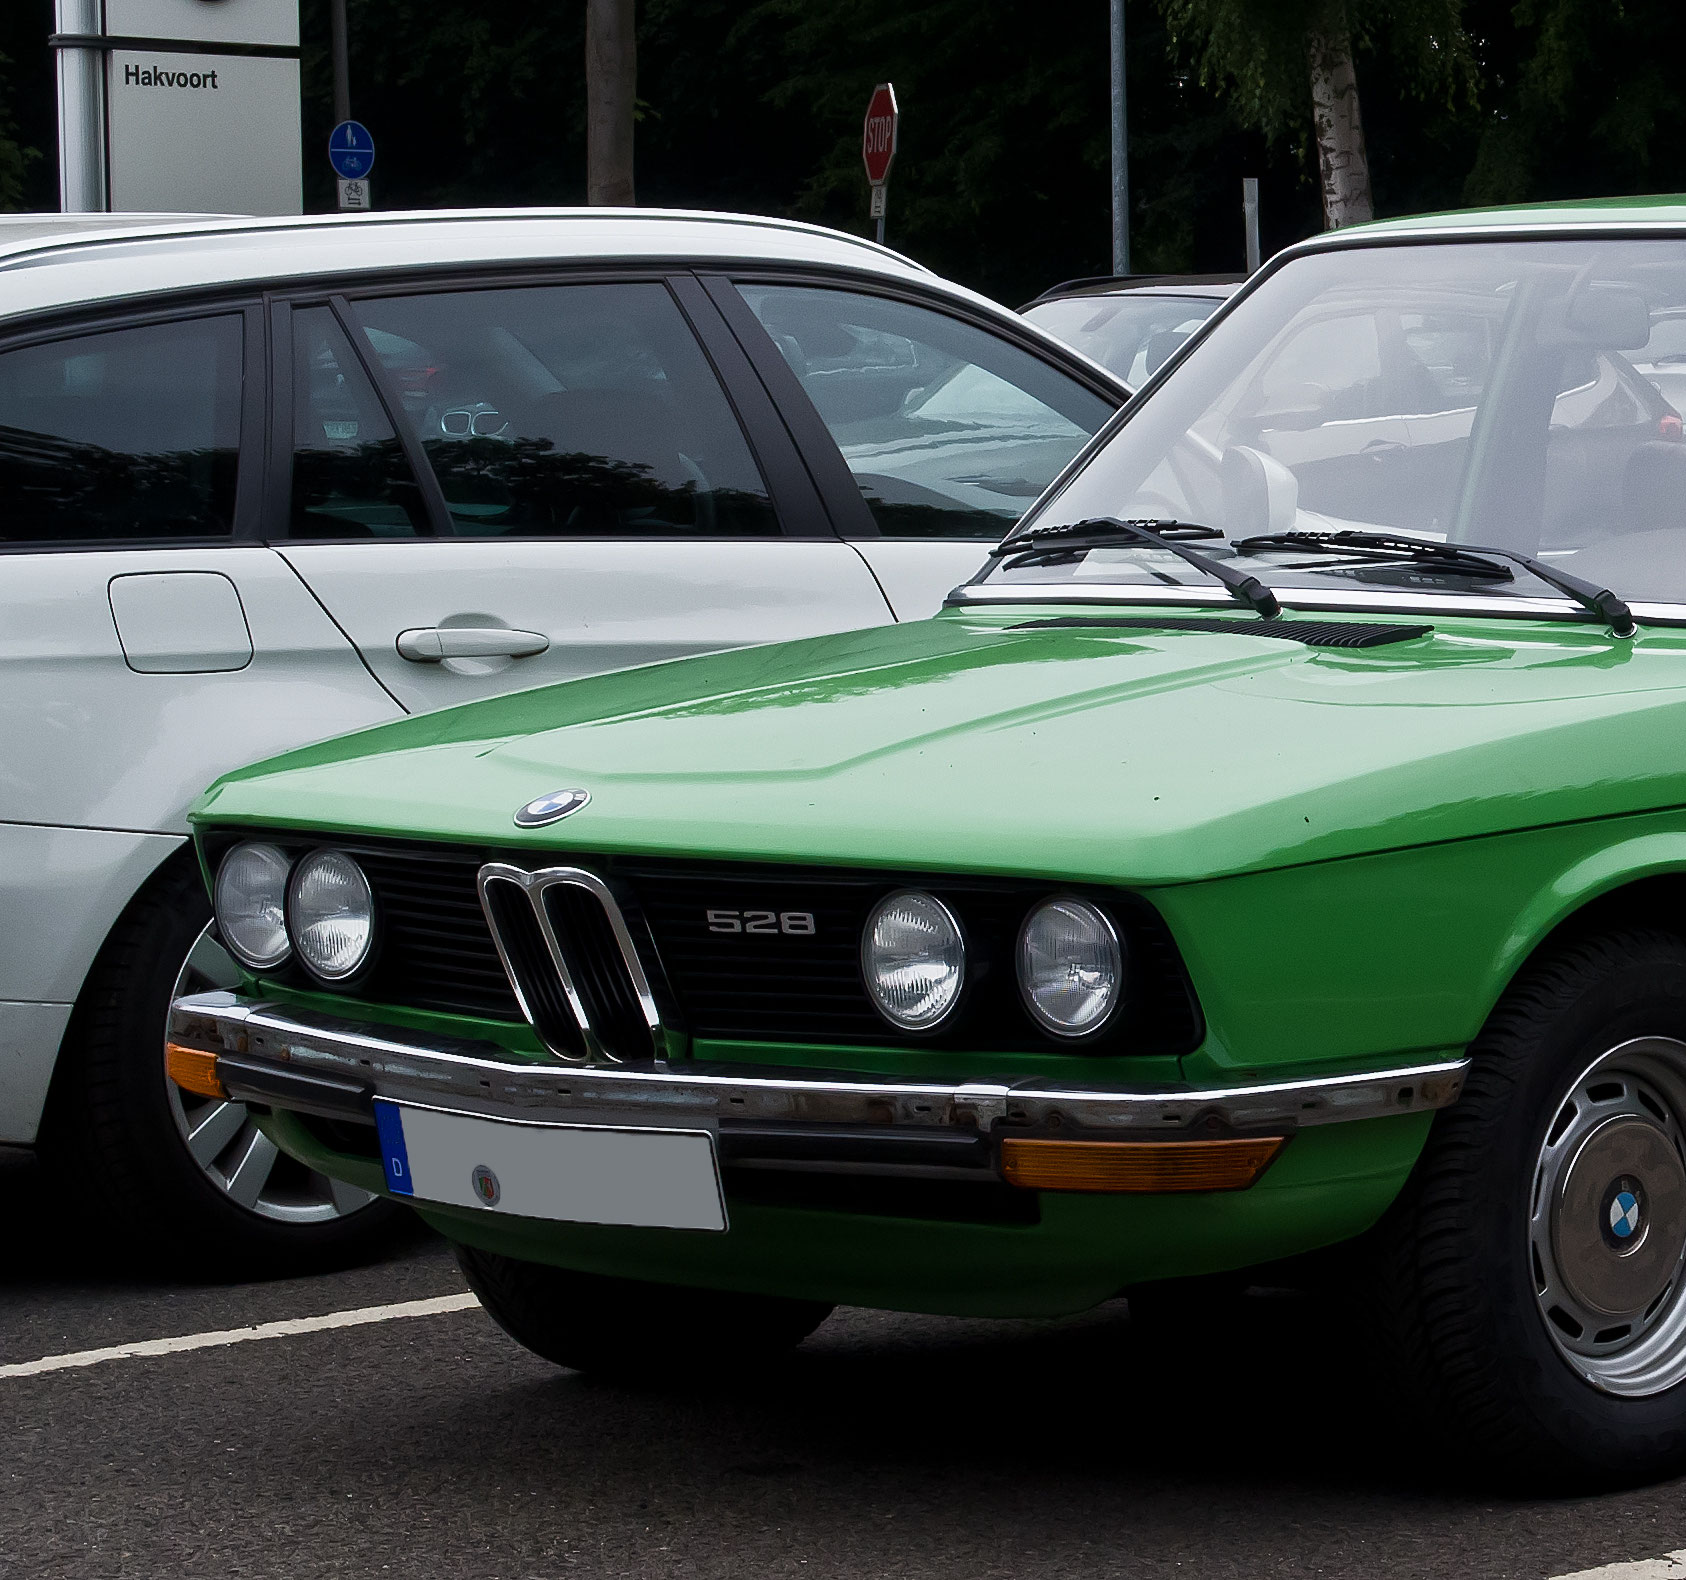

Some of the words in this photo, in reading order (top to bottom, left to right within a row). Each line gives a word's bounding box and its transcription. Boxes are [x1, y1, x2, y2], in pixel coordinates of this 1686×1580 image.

[124, 64, 218, 89] Hakvoort
[867, 115, 892, 154] STOP
[706, 909, 816, 935] 528
[391, 1157, 403, 1177] D
